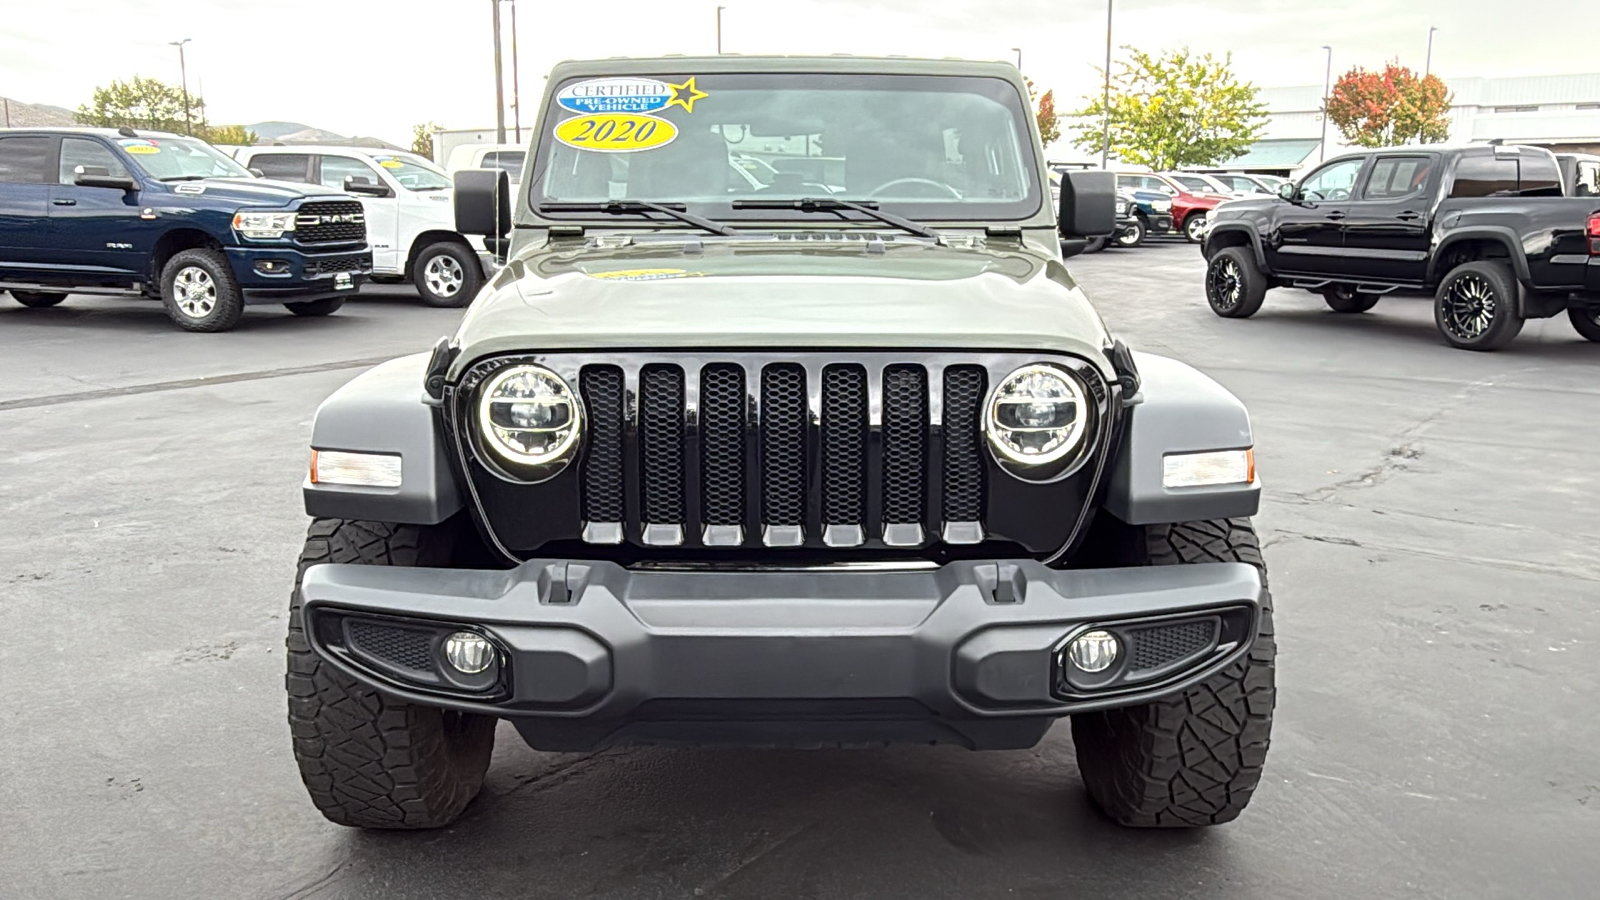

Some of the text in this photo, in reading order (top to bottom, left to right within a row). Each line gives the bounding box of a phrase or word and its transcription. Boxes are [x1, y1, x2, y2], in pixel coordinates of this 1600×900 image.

[572, 84, 665, 97] CERTIFIED
[576, 97, 661, 105] PRE-OWNED
[570, 120, 657, 142] 2020
[320, 214, 353, 223] RAM
